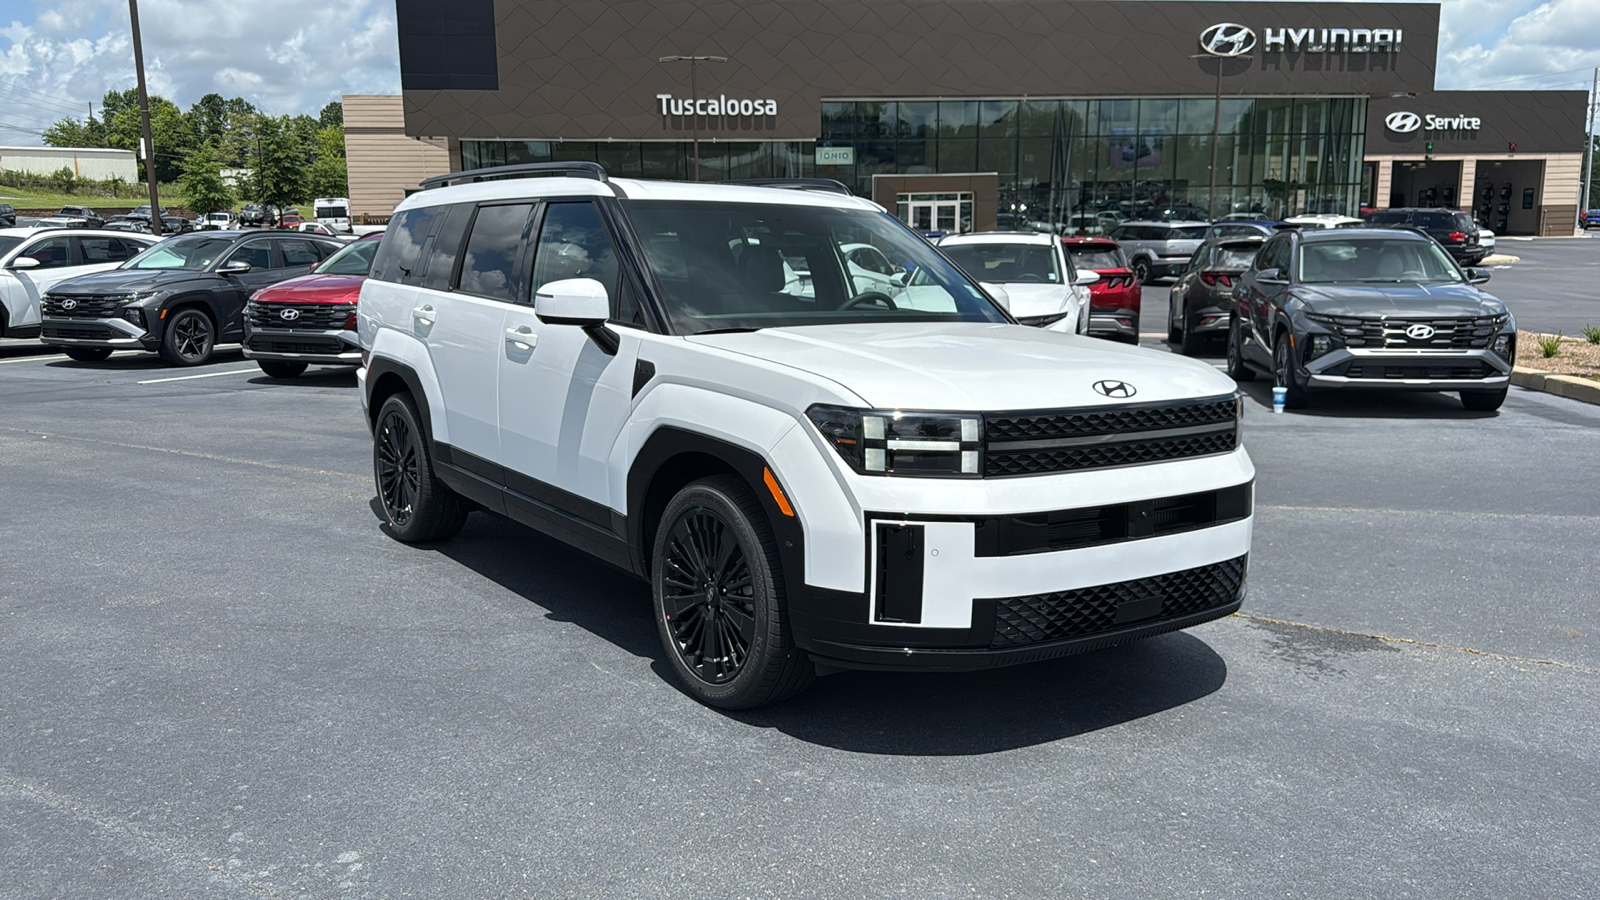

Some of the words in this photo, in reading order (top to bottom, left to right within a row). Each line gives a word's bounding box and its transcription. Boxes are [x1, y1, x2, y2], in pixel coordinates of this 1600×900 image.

[1265, 27, 1403, 52] HYUNDAI
[656, 94, 778, 116] Tuscaloosa
[1424, 113, 1481, 130] Service
